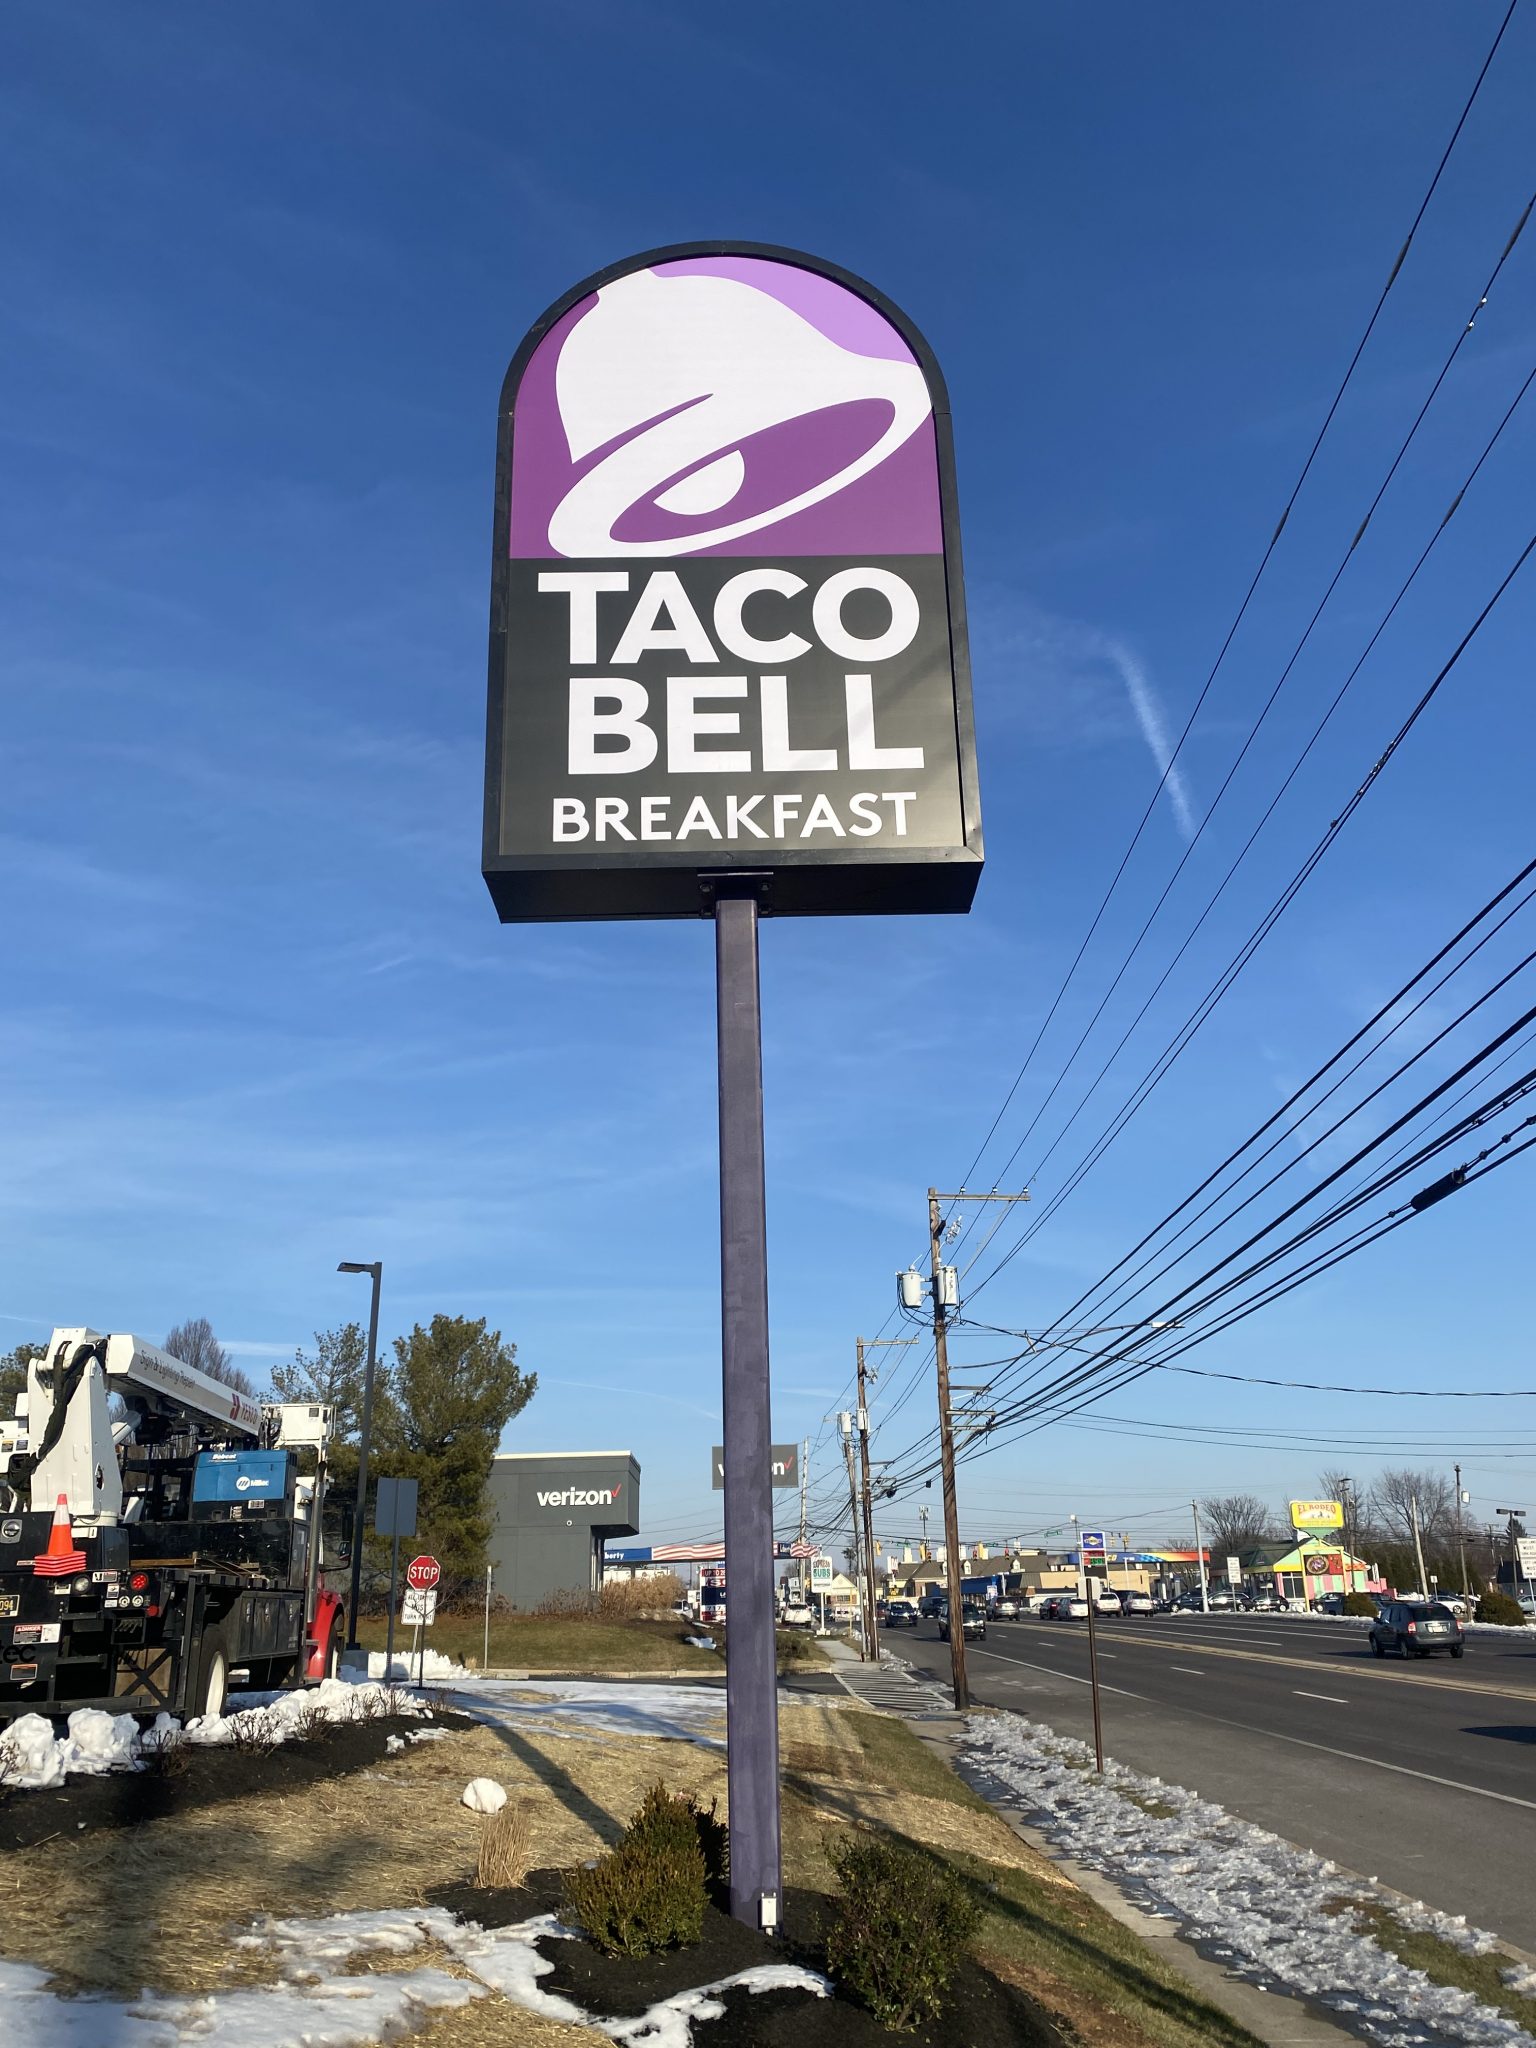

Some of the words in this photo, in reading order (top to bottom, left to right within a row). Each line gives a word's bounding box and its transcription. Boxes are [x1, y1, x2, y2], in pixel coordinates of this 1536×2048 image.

[537, 567, 920, 664] TACO
[567, 674, 925, 775] BELL
[552, 791, 917, 842] BREAKFAST
[536, 1486, 612, 1506] verizon
[1298, 1504, 1306, 1515] EL
[1308, 1504, 1336, 1514] RODEO
[604, 1551, 624, 1560] berty
[410, 1566, 438, 1580] STOP
[813, 1568, 831, 1578] SUBS
